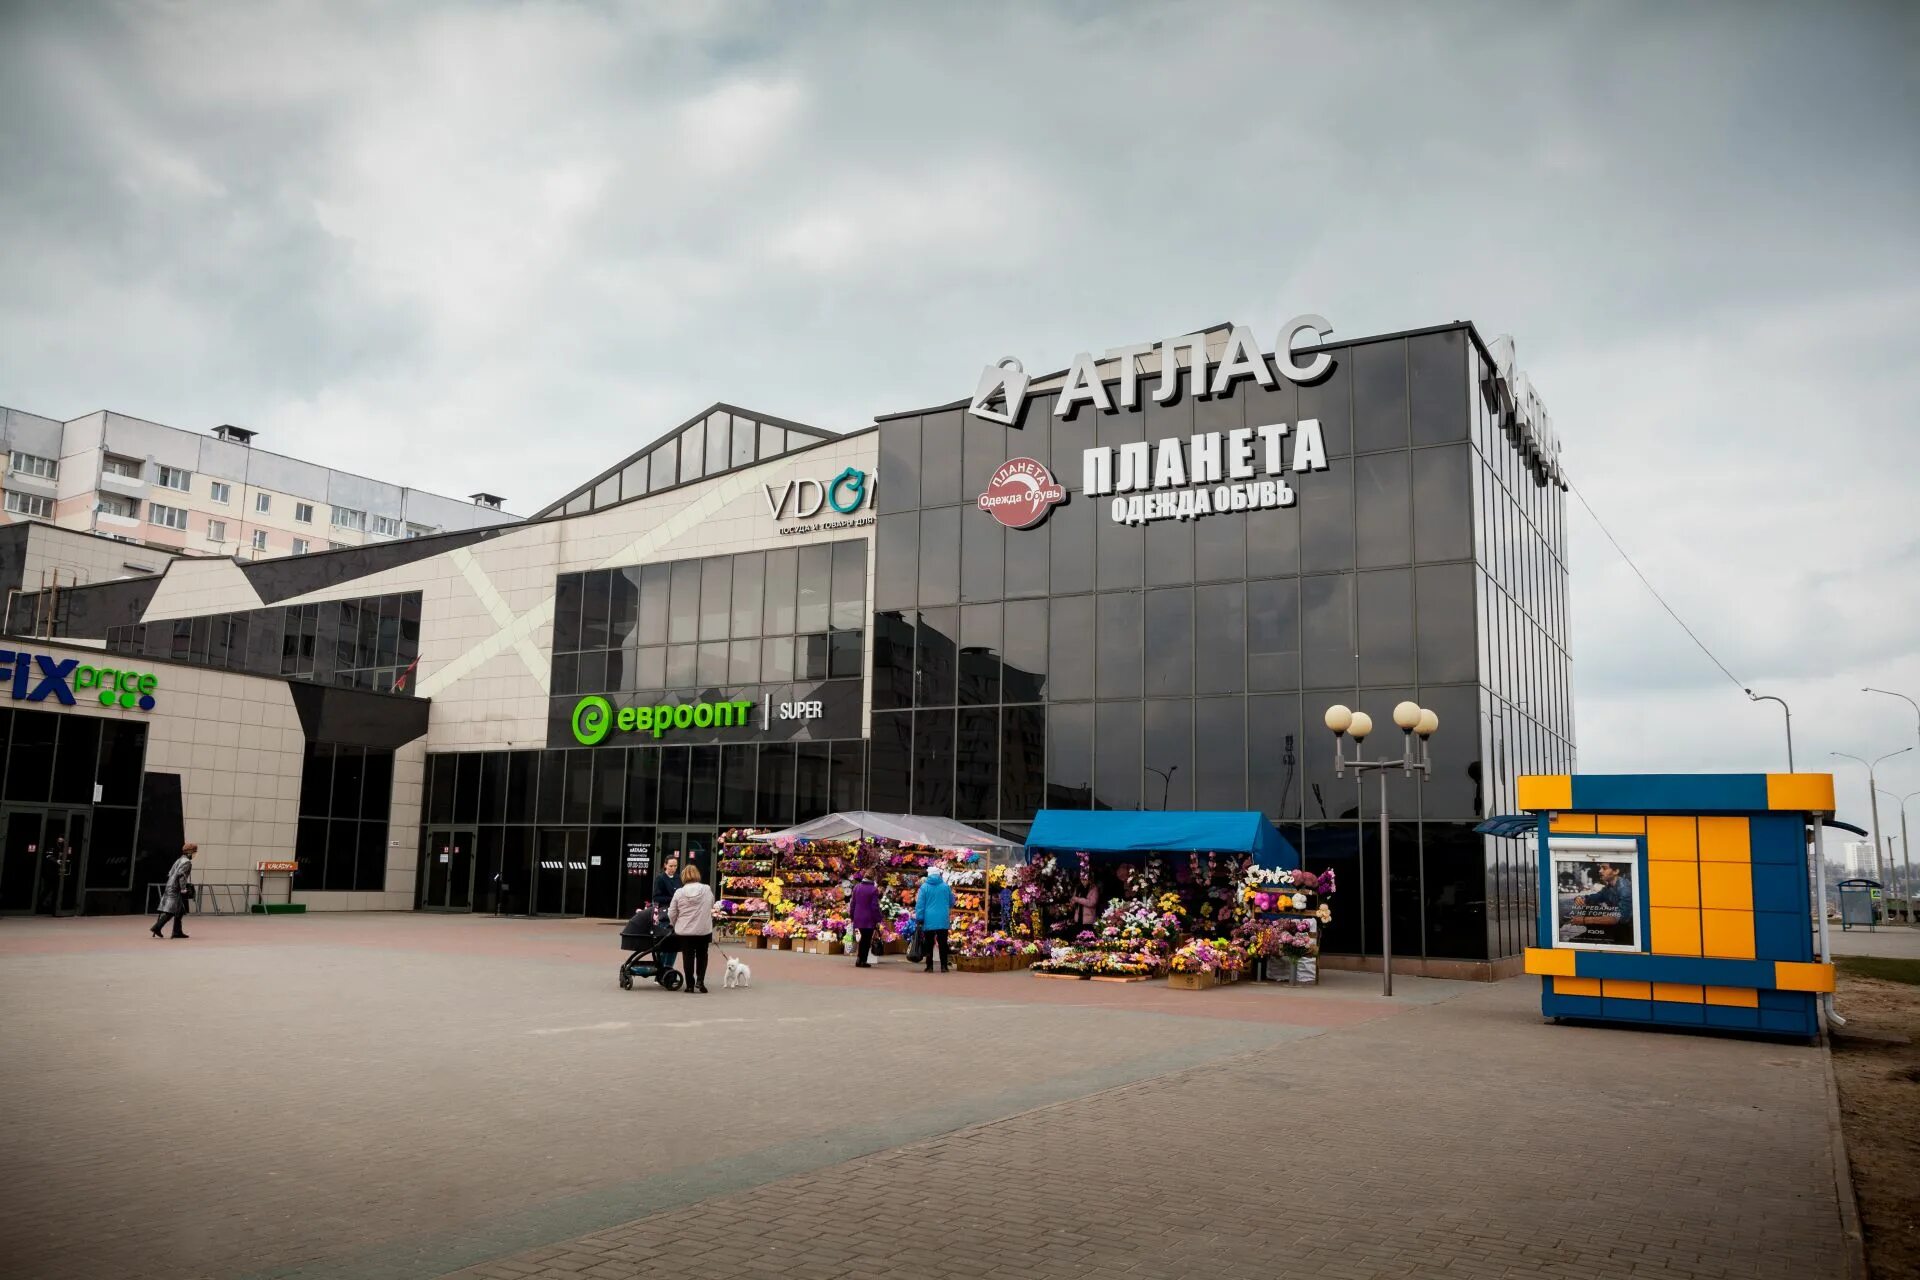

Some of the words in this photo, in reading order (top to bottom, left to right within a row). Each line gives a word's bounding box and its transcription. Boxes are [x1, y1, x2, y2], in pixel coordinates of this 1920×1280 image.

[1053, 314, 1334, 417] АТЛАС
[1083, 418, 1328, 496] ПЛАНЕТА
[992, 462, 1047, 488] ПЛАНЕТА
[980, 494, 1022, 508] Одежда
[1024, 489, 1060, 502] Обувь
[1111, 488, 1212, 525] ОДЕЖДА
[1214, 480, 1295, 513] ОБУВЬ
[822, 519, 855, 530] ТОВАРЫ
[855, 517, 875, 527] ДЛЯ
[74, 664, 158, 695] price
[617, 701, 753, 739] евроопт
[779, 700, 823, 720] SUPER
